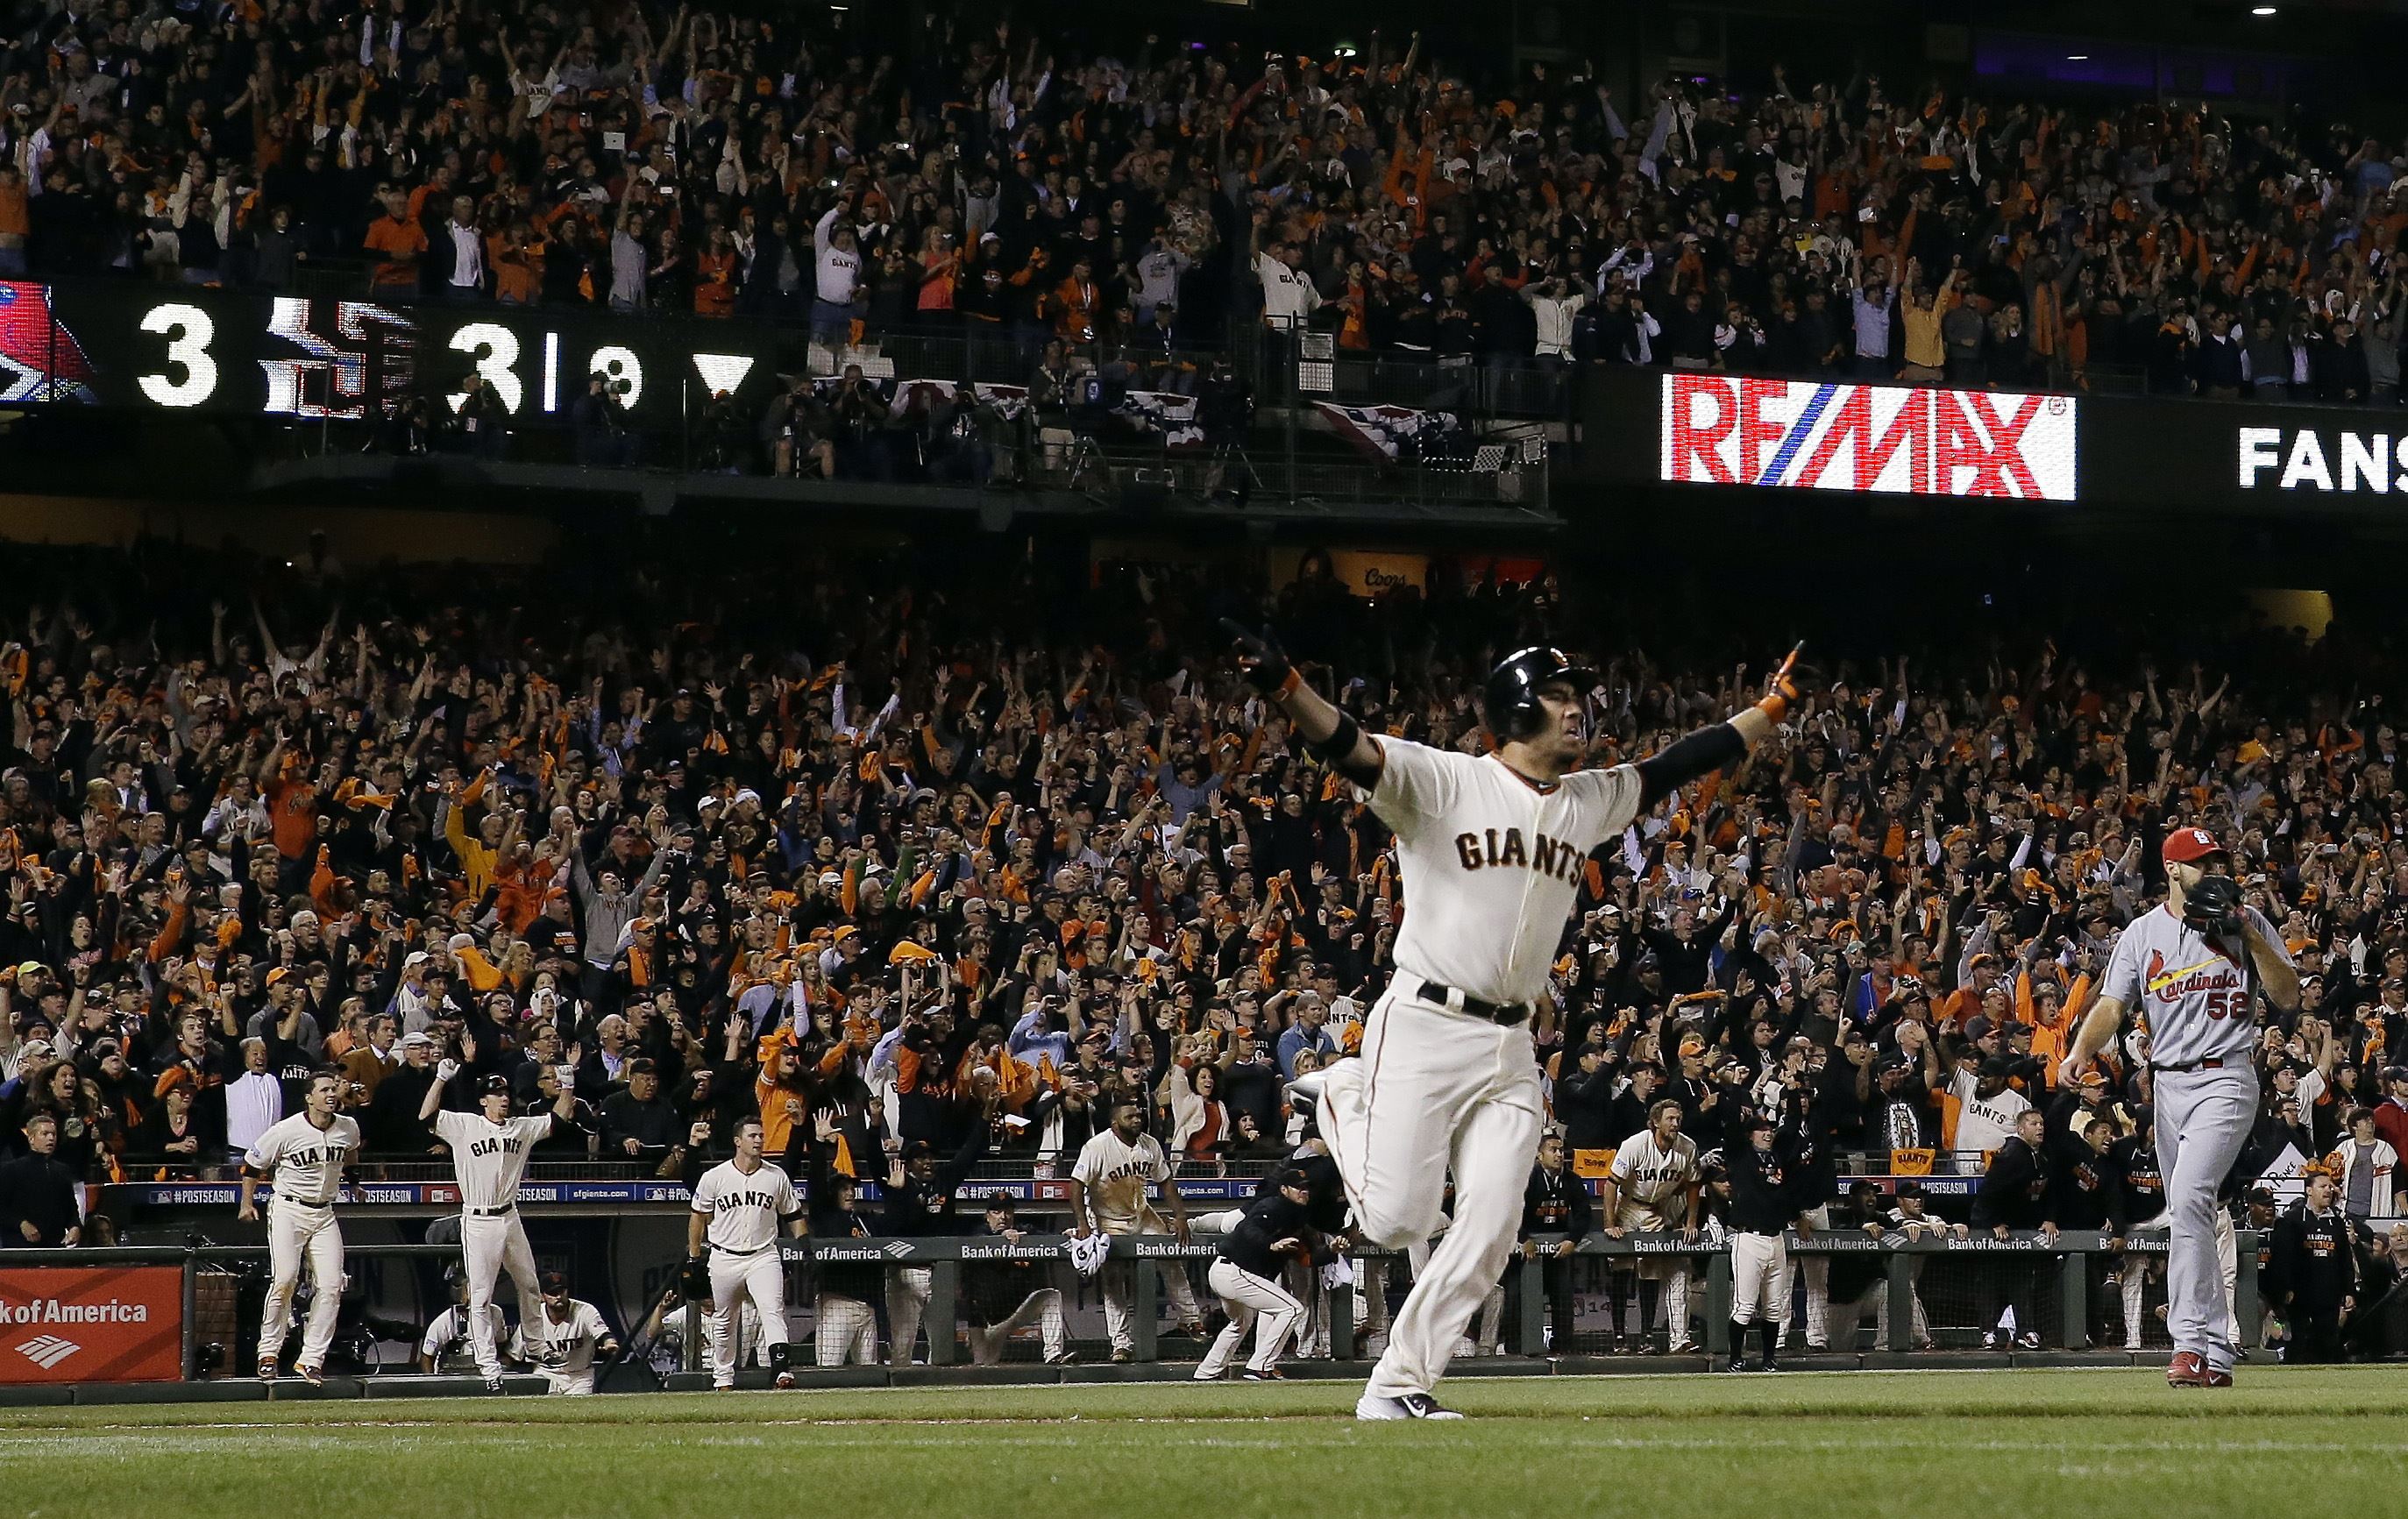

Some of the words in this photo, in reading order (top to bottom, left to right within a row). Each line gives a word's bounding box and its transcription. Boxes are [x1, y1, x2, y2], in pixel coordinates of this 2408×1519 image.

[139, 303, 218, 407] 3
[444, 323, 522, 416] 3
[1671, 373, 2044, 500] RE/MAX
[1454, 827, 1588, 888] GIANTS
[2156, 971, 2239, 1004] Cardinals
[2207, 992, 2249, 1019] 52
[174, 1189, 237, 1204] #POSTSEASON
[572, 1189, 629, 1200] sfgiants.com
[715, 1190, 775, 1214] GIANTS
[1136, 1242, 1167, 1256] Bank
[1167, 1241, 1181, 1255] of
[1181, 1242, 1217, 1255] Ameri
[1633, 1239, 1662, 1253] Bank
[1662, 1239, 1676, 1252] of
[1676, 1239, 1723, 1252] America
[1792, 1237, 1821, 1251] Bank
[1821, 1236, 1834, 1250] of
[1833, 1237, 1879, 1251] America
[1947, 1236, 1976, 1251] Bank
[1976, 1237, 1989, 1250] of
[1988, 1237, 2033, 1251] America
[2127, 1238, 2141, 1251] of
[2140, 1237, 2170, 1251] Ameri
[815, 1246, 829, 1260] of
[830, 1246, 882, 1260] America
[961, 1245, 993, 1259] Bank
[993, 1244, 1007, 1259] of
[1007, 1244, 1059, 1257] America
[15, 1299, 42, 1324] of
[44, 1299, 147, 1324] America
